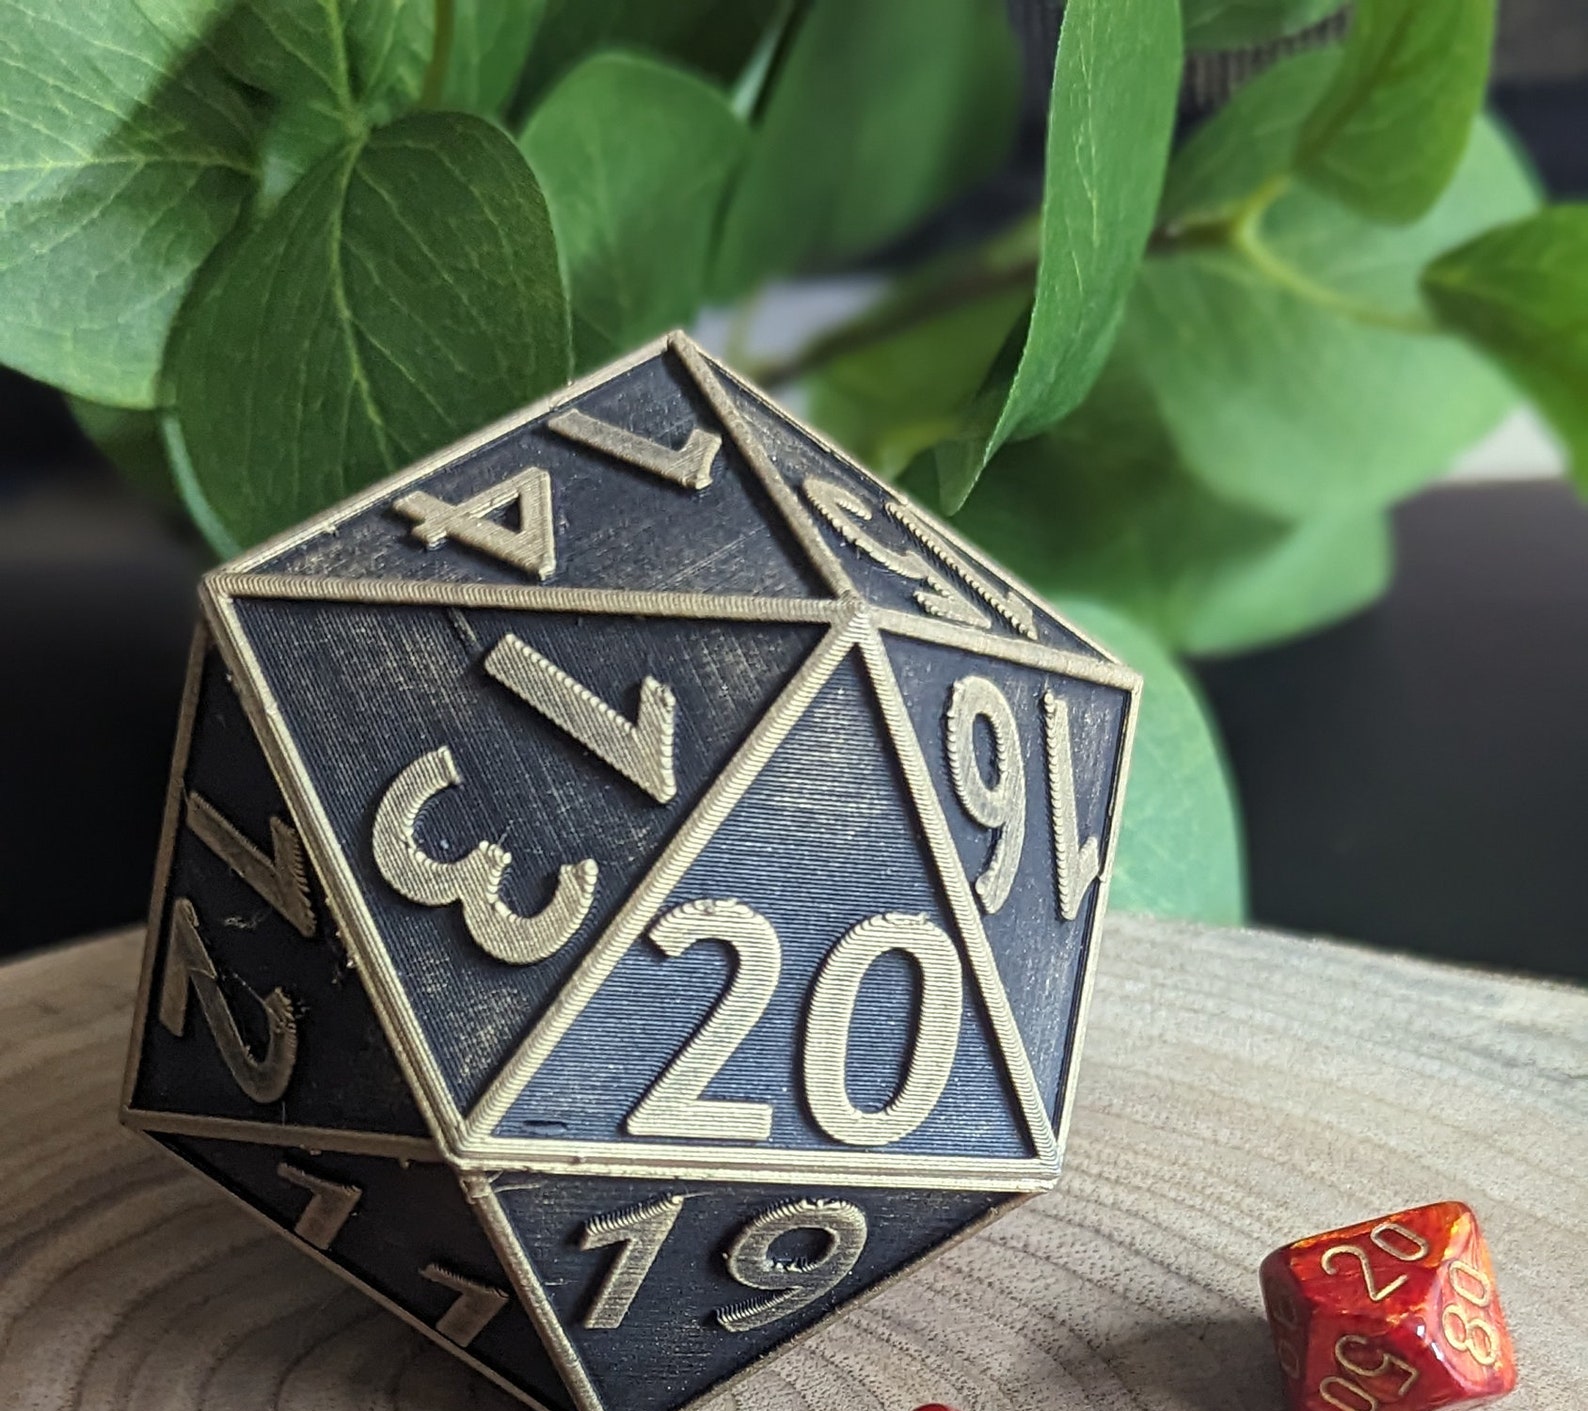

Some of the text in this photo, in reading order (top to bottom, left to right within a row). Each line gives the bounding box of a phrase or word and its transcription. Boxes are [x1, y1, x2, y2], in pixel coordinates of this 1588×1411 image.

[393, 408, 722, 581] 14
[371, 632, 677, 966] 13
[624, 897, 964, 1146] 20
[578, 1193, 868, 1333] 19
[1320, 1222, 1429, 1302] 20
[1442, 1260, 1498, 1366] 80
